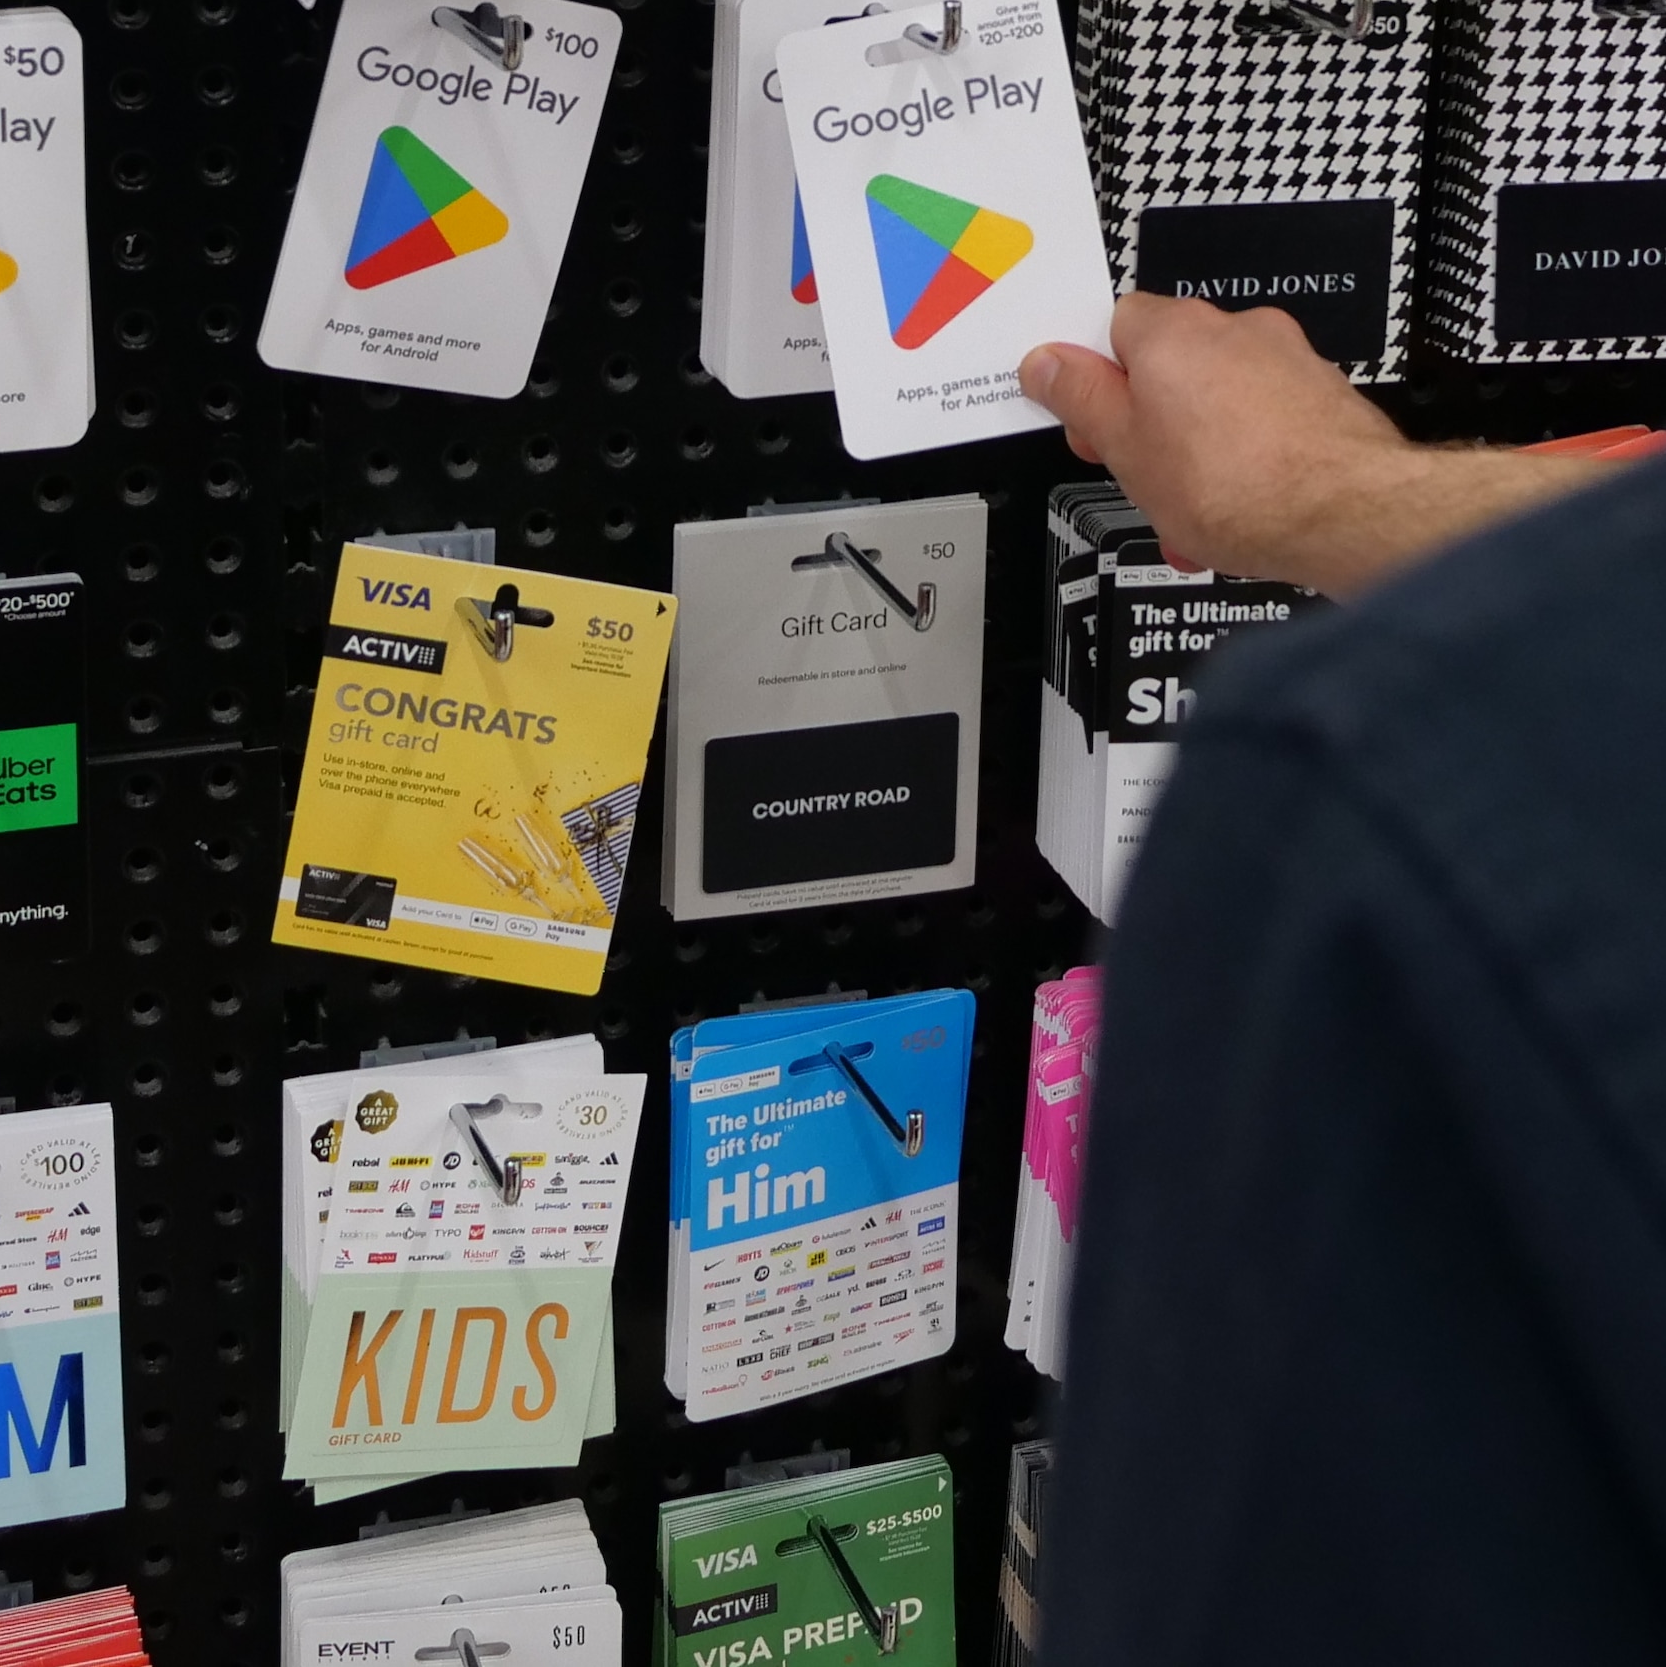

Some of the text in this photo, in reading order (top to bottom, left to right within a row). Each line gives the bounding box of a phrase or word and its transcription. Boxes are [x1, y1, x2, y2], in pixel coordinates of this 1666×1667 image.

[1534, 247, 1622, 271] DAVID
[922, 542, 955, 560] $50
[357, 576, 433, 611] VISA
[587, 616, 635, 643] $50
[781, 608, 888, 638] Gift Card
[758, 663, 907, 686] Redeemable in store and online
[334, 683, 558, 746] CONGRATS
[328, 719, 440, 754] gift card
[752, 787, 910, 819] COUNTRY ROAD
[706, 1090, 846, 1136] The Ultimate
[706, 1132, 782, 1167] gift for
[707, 1163, 825, 1231] Him
[332, 1302, 569, 1429] KIDS
[866, 1503, 944, 1536] $25-$500
[691, 1548, 759, 1579] VISA
[318, 1641, 396, 1660] EVENT
